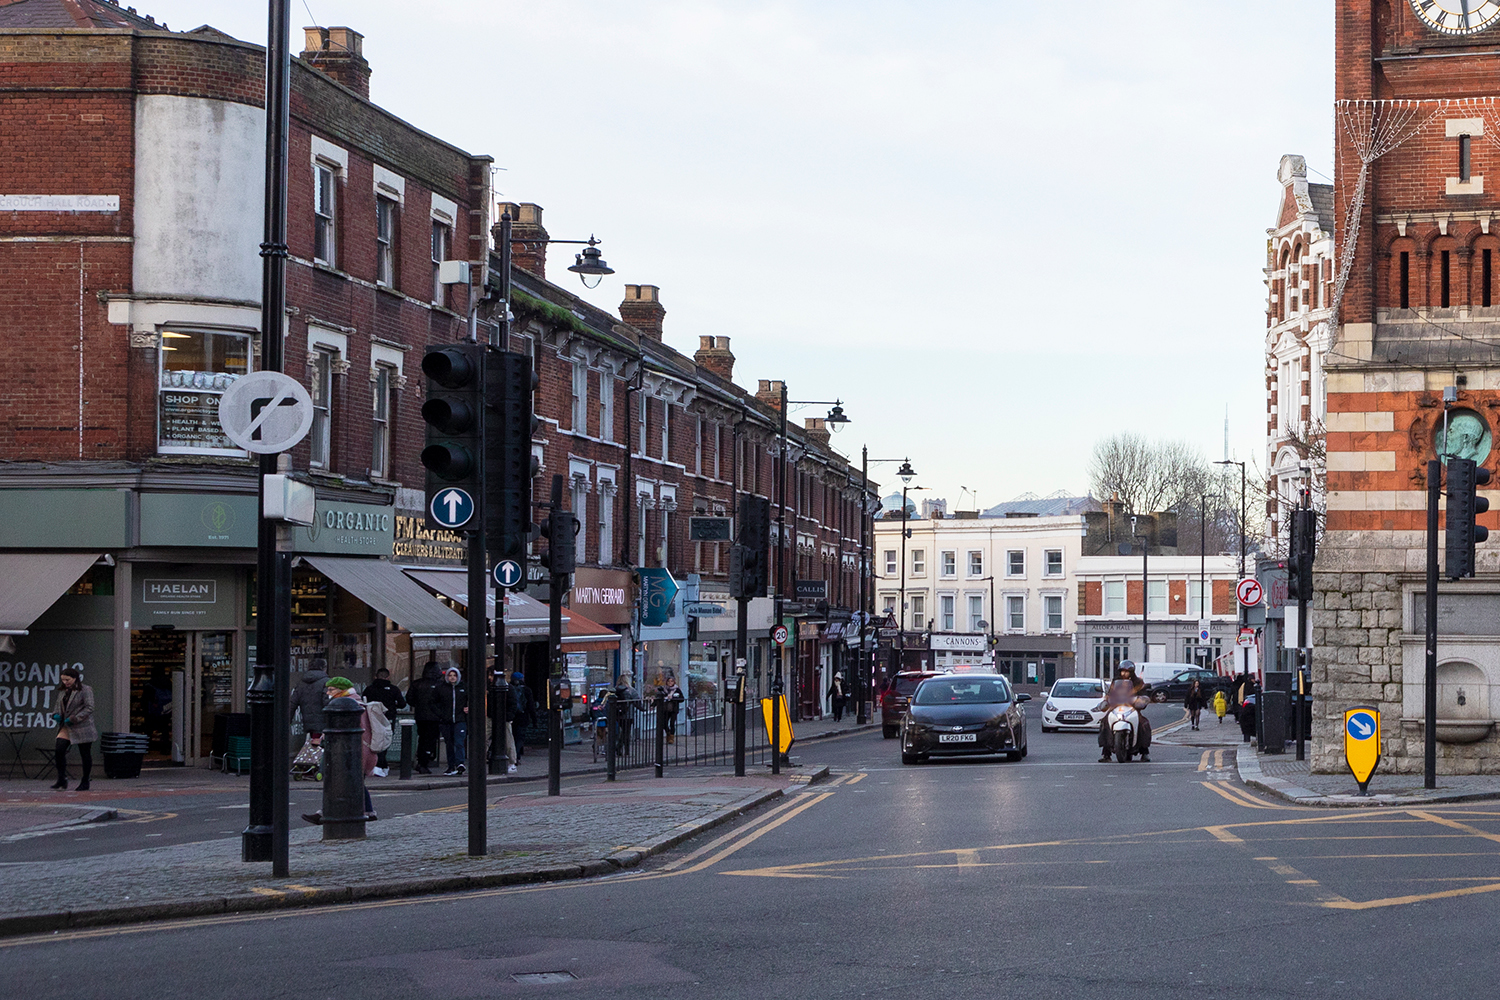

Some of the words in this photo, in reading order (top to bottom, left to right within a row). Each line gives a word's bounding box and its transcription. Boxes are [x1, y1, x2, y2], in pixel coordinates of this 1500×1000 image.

[166, 396, 198, 404] SHOP
[326, 510, 389, 532] ORGANIC
[336, 536, 358, 544] HEALTH
[360, 537, 376, 545] STORE
[151, 584, 208, 593] HAELAN
[650, 576, 667, 608] MG
[576, 588, 600, 604] MARTYN
[600, 588, 625, 604] GERRARD
[776, 631, 786, 639] 20
[0, 712, 57, 728] GETAB
